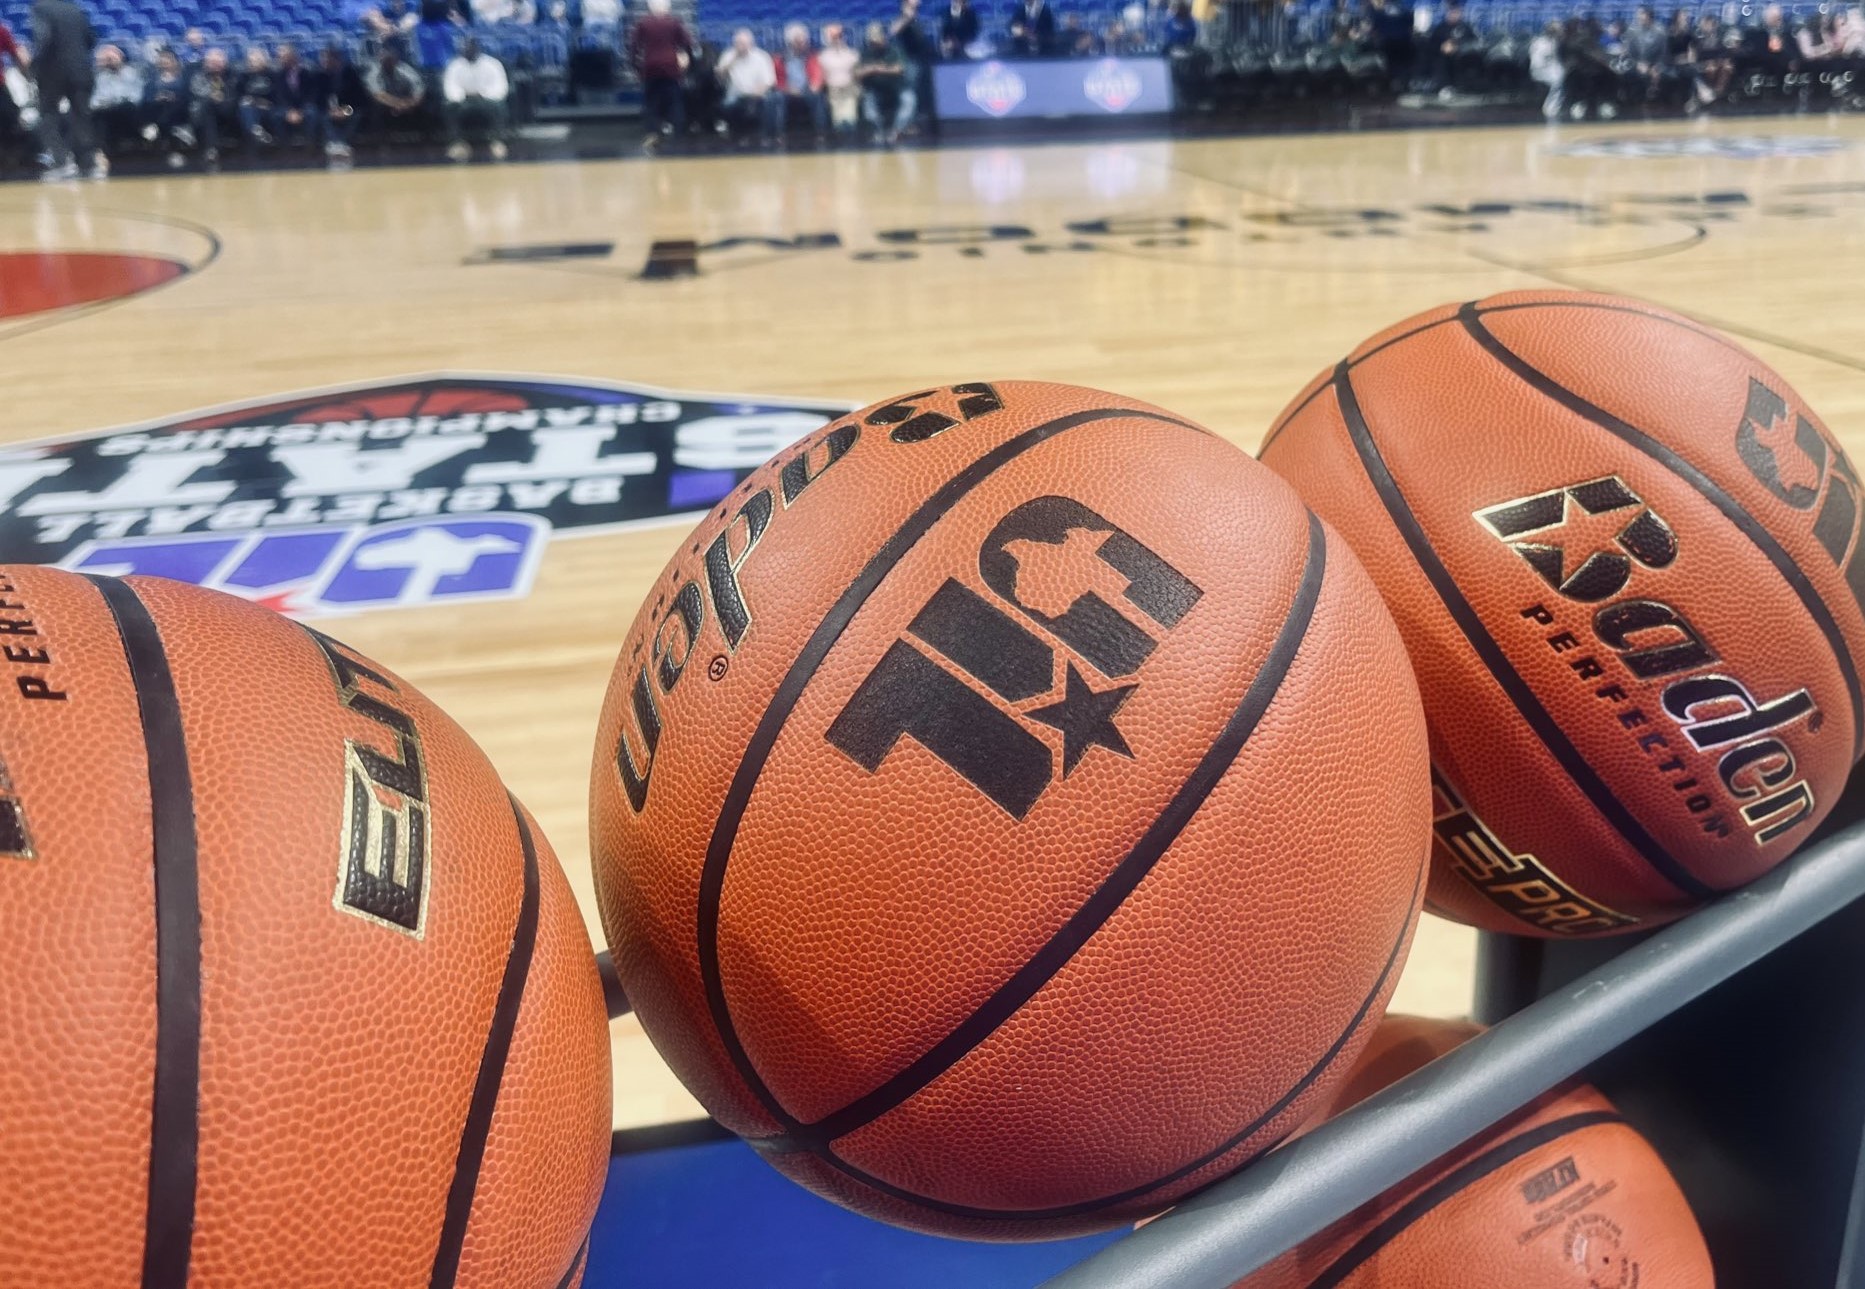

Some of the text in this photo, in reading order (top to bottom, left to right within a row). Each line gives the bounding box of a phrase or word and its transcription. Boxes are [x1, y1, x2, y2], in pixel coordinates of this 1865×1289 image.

[37, 475, 623, 544] BASKETBALL
[97, 402, 682, 457] CHAMPIONSHIPS
[616, 380, 1004, 815] Baden
[824, 495, 1205, 822] UIL
[1471, 474, 1819, 846] Baden
[1518, 603, 1731, 840] PERFECTION
